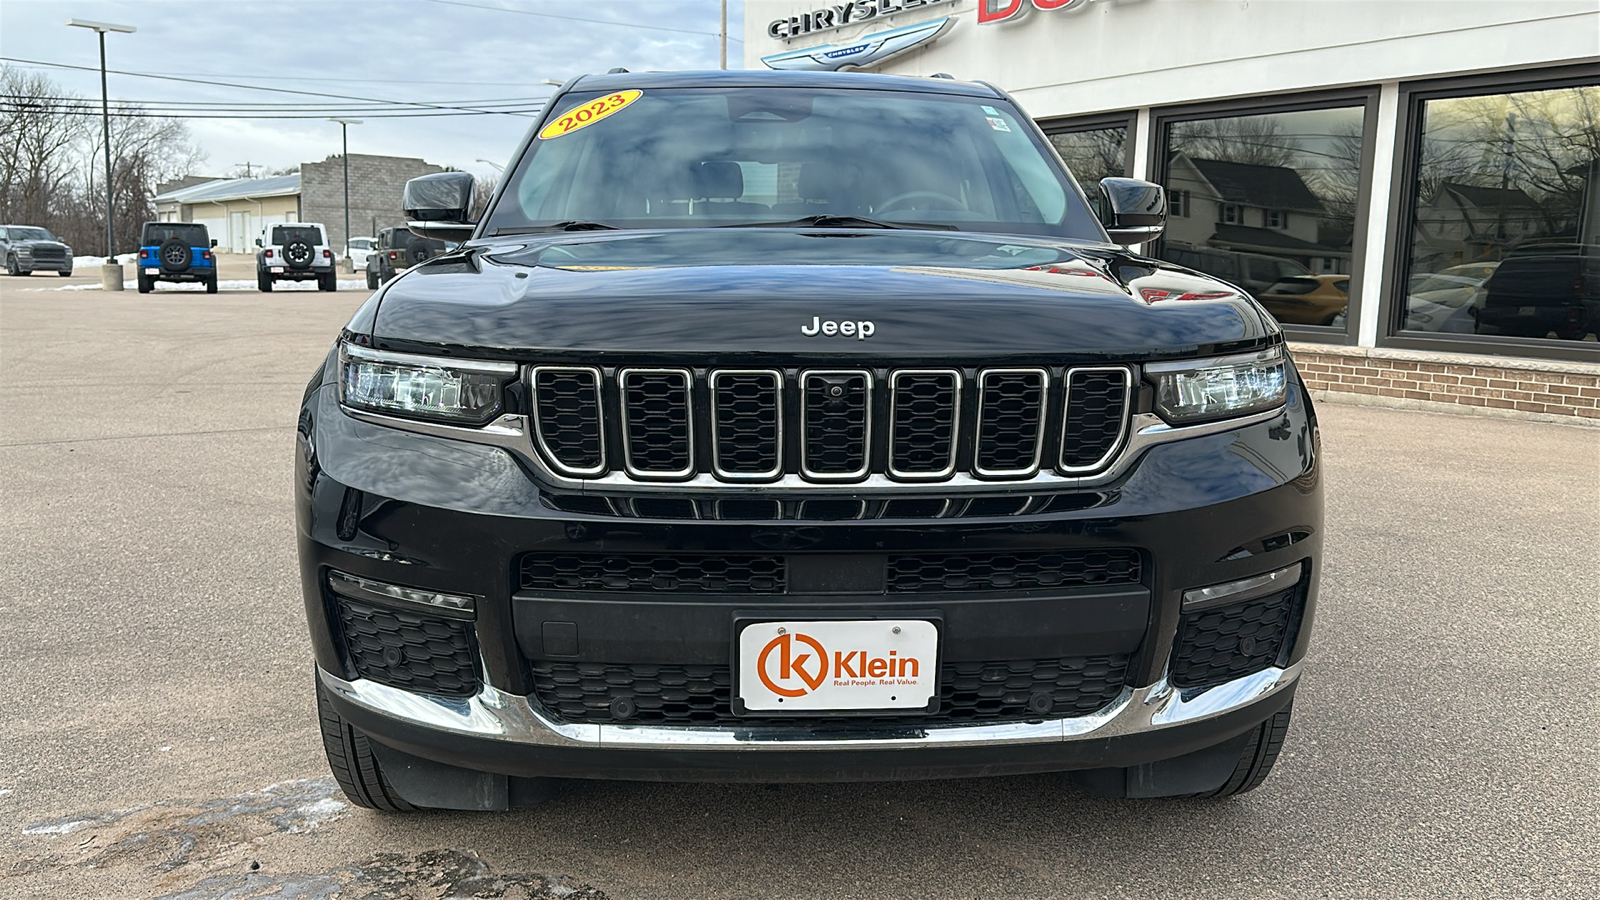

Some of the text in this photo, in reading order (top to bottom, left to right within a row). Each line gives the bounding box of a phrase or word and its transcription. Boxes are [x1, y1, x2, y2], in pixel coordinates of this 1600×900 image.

[767, 0, 941, 38] CHRYSL
[558, 94, 626, 132] 2023
[801, 316, 875, 340] Jeep
[834, 650, 919, 678] Klein
[896, 678, 919, 686] Value.
